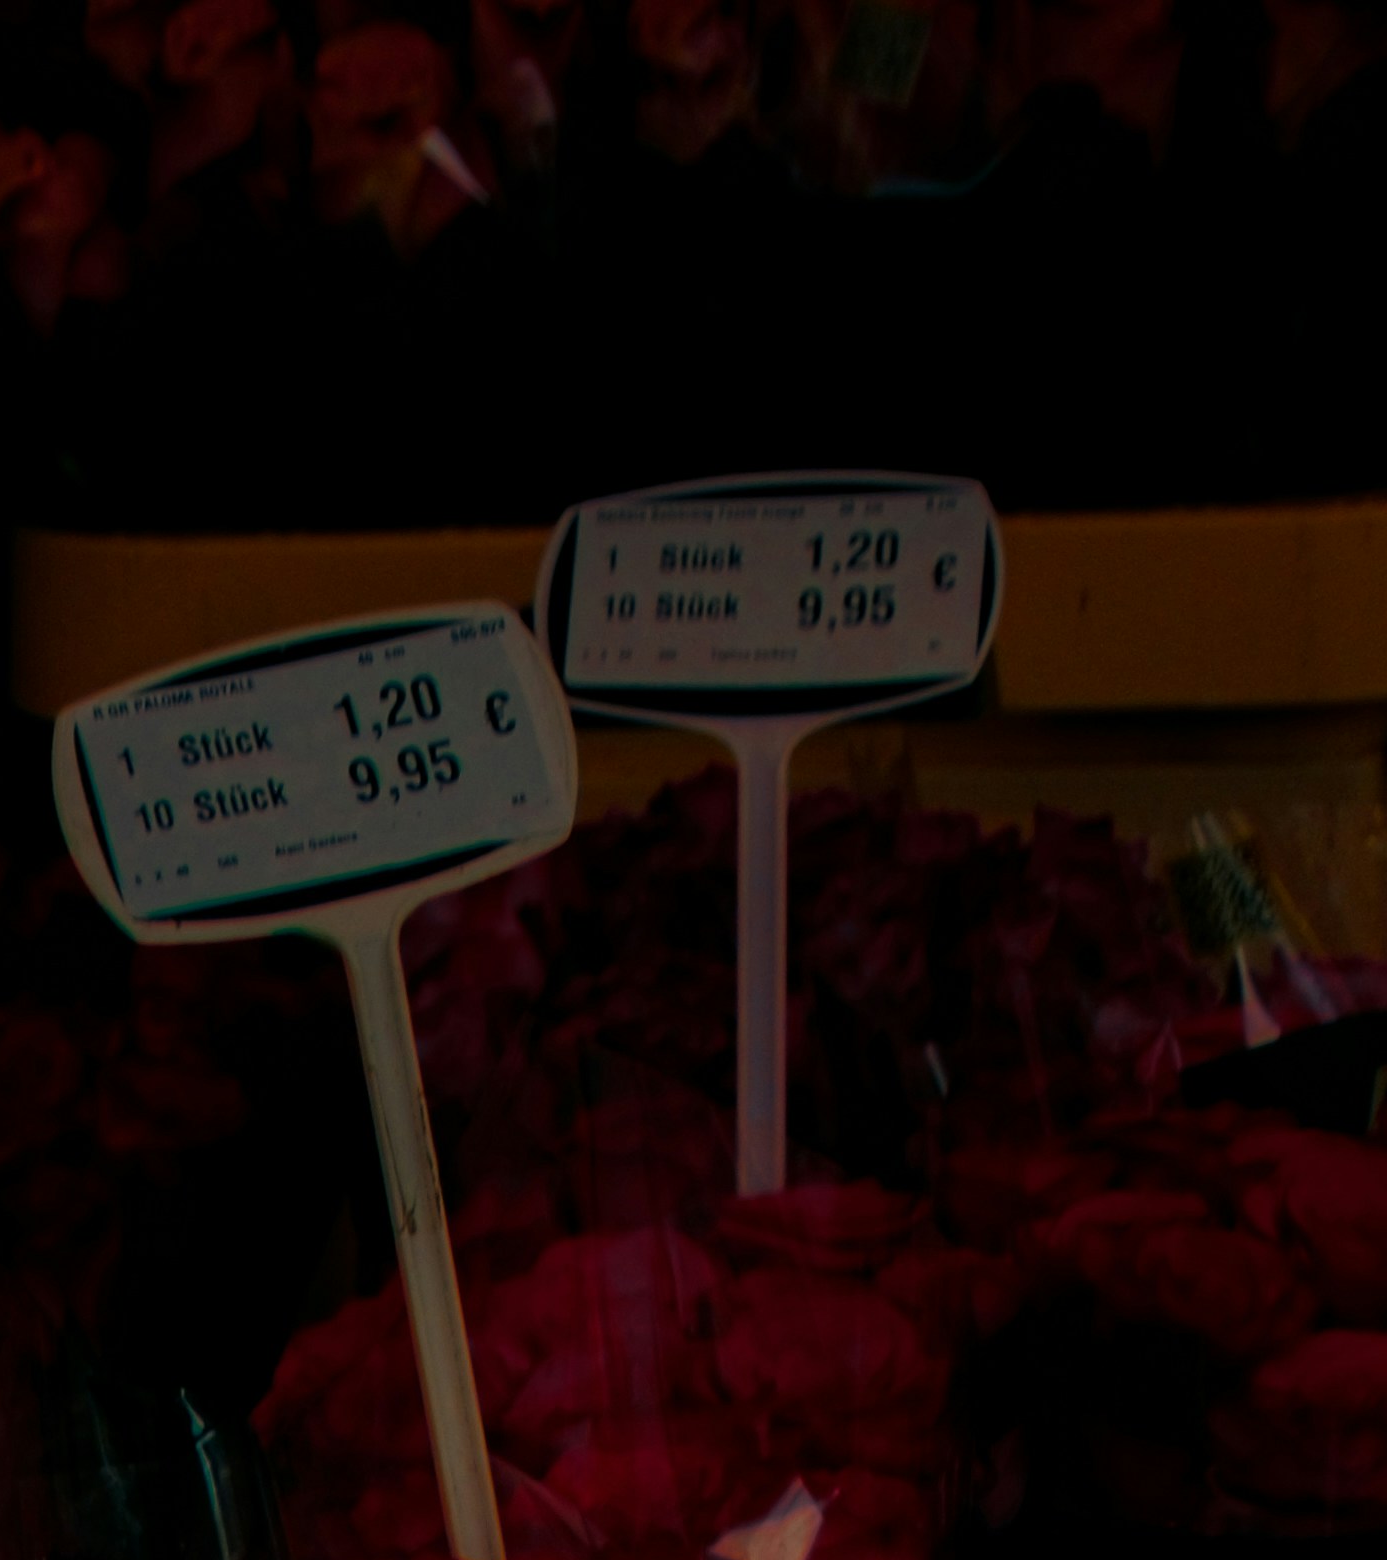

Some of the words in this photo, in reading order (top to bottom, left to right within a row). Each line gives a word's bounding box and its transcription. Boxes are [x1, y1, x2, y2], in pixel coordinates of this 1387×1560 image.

[608, 544, 618, 573] 1
[659, 541, 743, 574] Stück
[807, 529, 901, 577] 1,20
[933, 552, 958, 592] €
[605, 592, 636, 622] 10
[656, 590, 739, 623] Stück
[798, 586, 897, 634] 9,95
[117, 746, 136, 778] 1
[178, 722, 275, 769] Stück
[334, 672, 445, 742] 1,20
[484, 690, 518, 735] €
[136, 798, 176, 836] 10
[193, 778, 290, 825] Stück
[348, 738, 463, 805] 9,95
